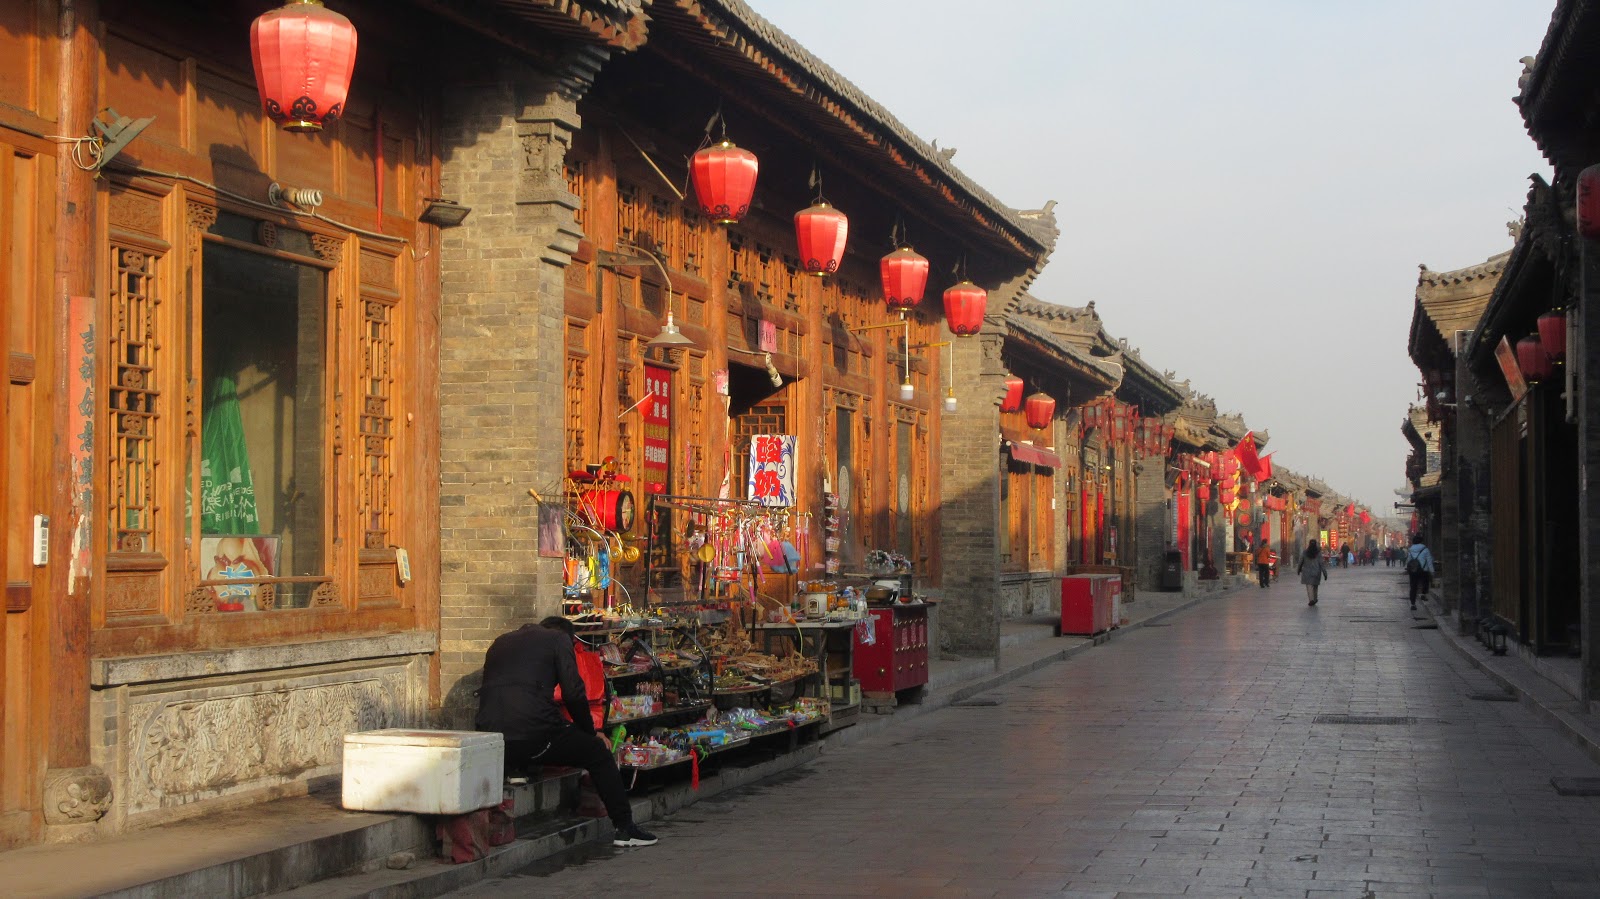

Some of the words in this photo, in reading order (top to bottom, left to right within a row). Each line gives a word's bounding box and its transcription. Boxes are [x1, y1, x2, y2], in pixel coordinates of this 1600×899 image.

[645, 377, 669, 398] 充电宝
[649, 401, 669, 420] 据线
[754, 436, 782, 499] 酸奶
